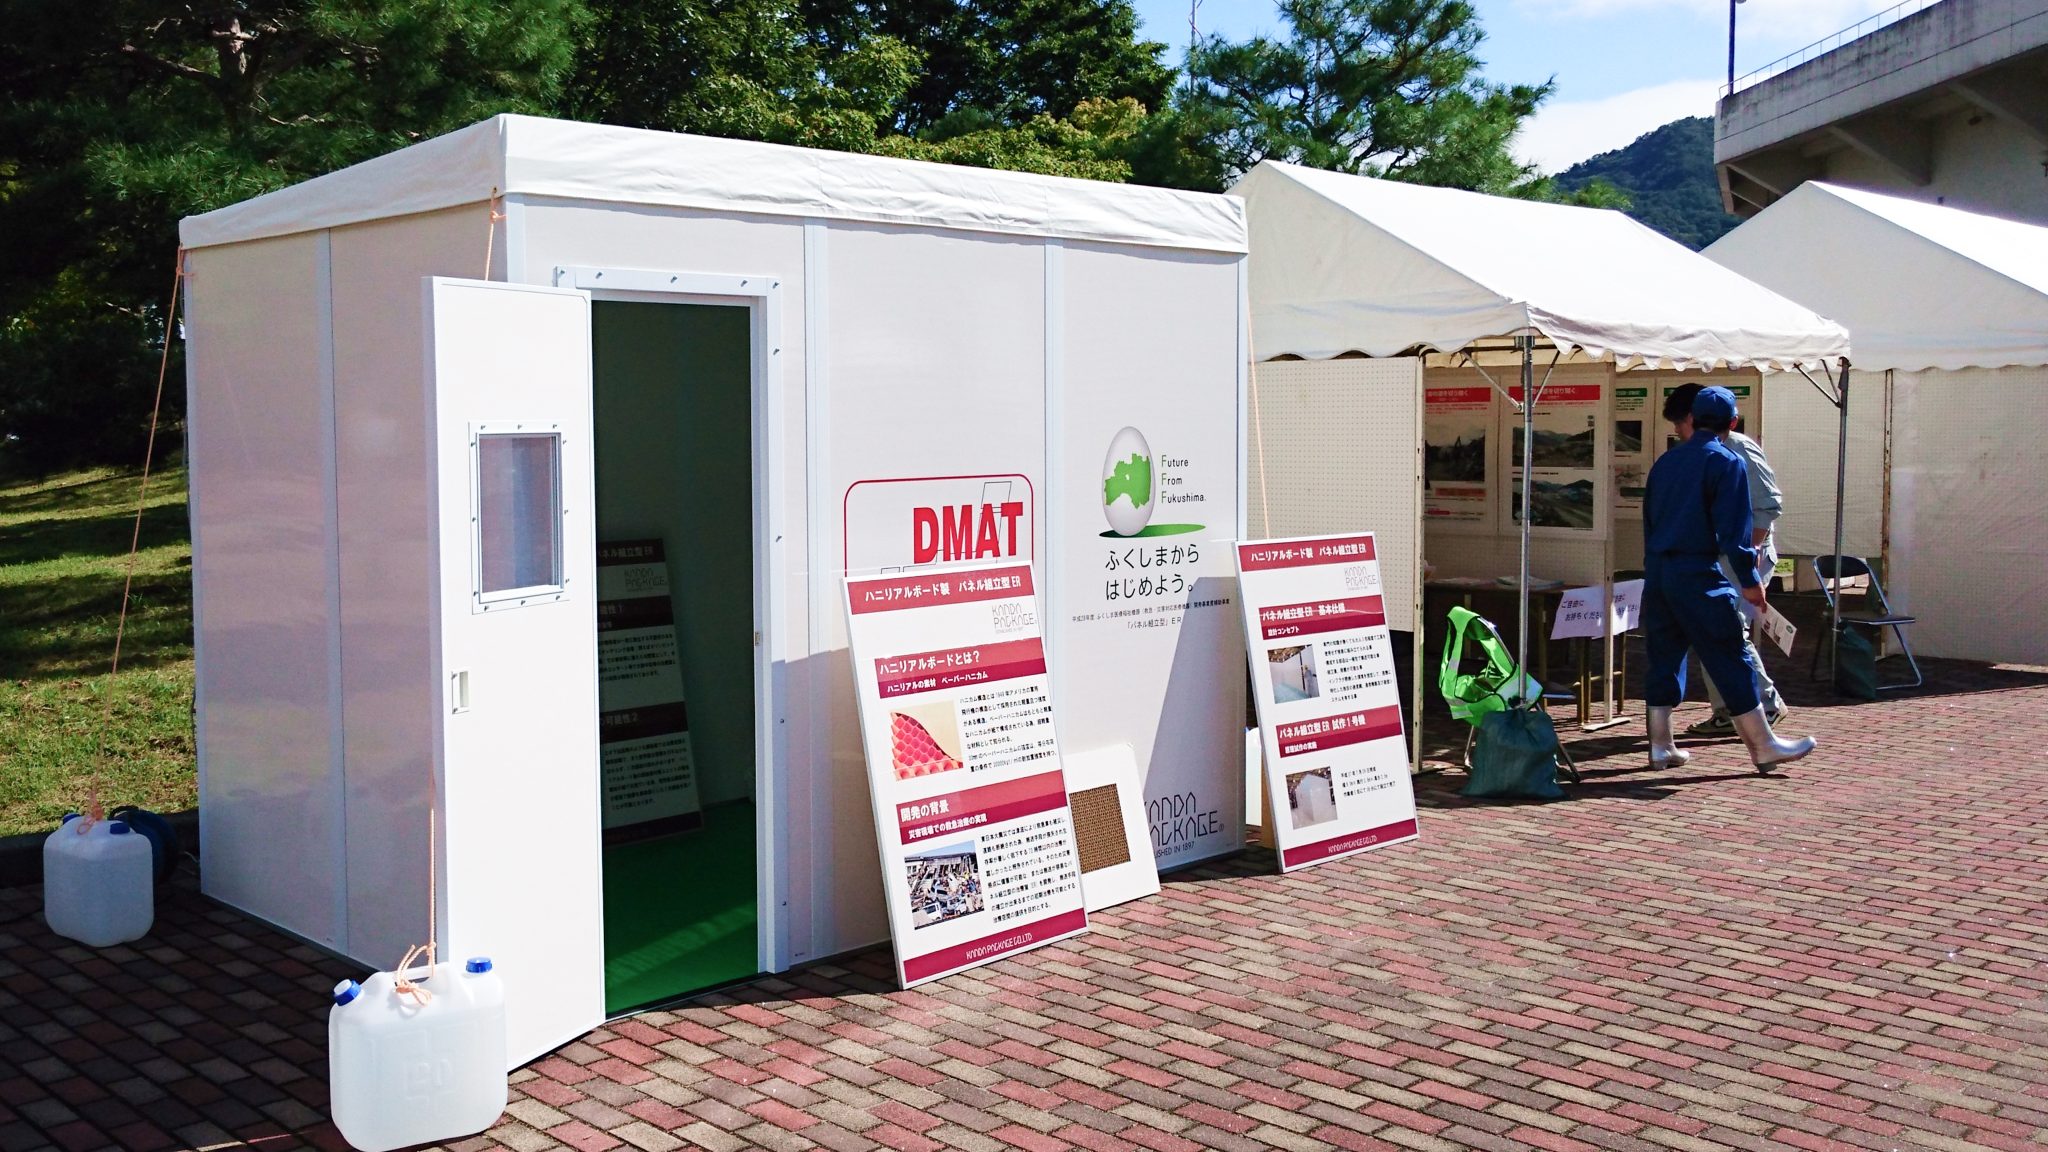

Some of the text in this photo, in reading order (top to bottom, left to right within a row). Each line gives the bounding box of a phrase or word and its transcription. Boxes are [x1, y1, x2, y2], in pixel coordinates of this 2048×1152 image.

[1161, 455, 1189, 467] Future
[1161, 473, 1183, 485] From
[913, 501, 1024, 564] DMAT
[1105, 544, 1200, 571] ふくしまから
[865, 582, 950, 602] ハニリアルボード製
[1106, 573, 1194, 600] はじめよう。
[941, 671, 988, 684] ペーパーハニカム
[900, 799, 950, 823] 開発の背景
[1144, 791, 1196, 823] ANDA
[1150, 810, 1218, 847] ACKAGE
